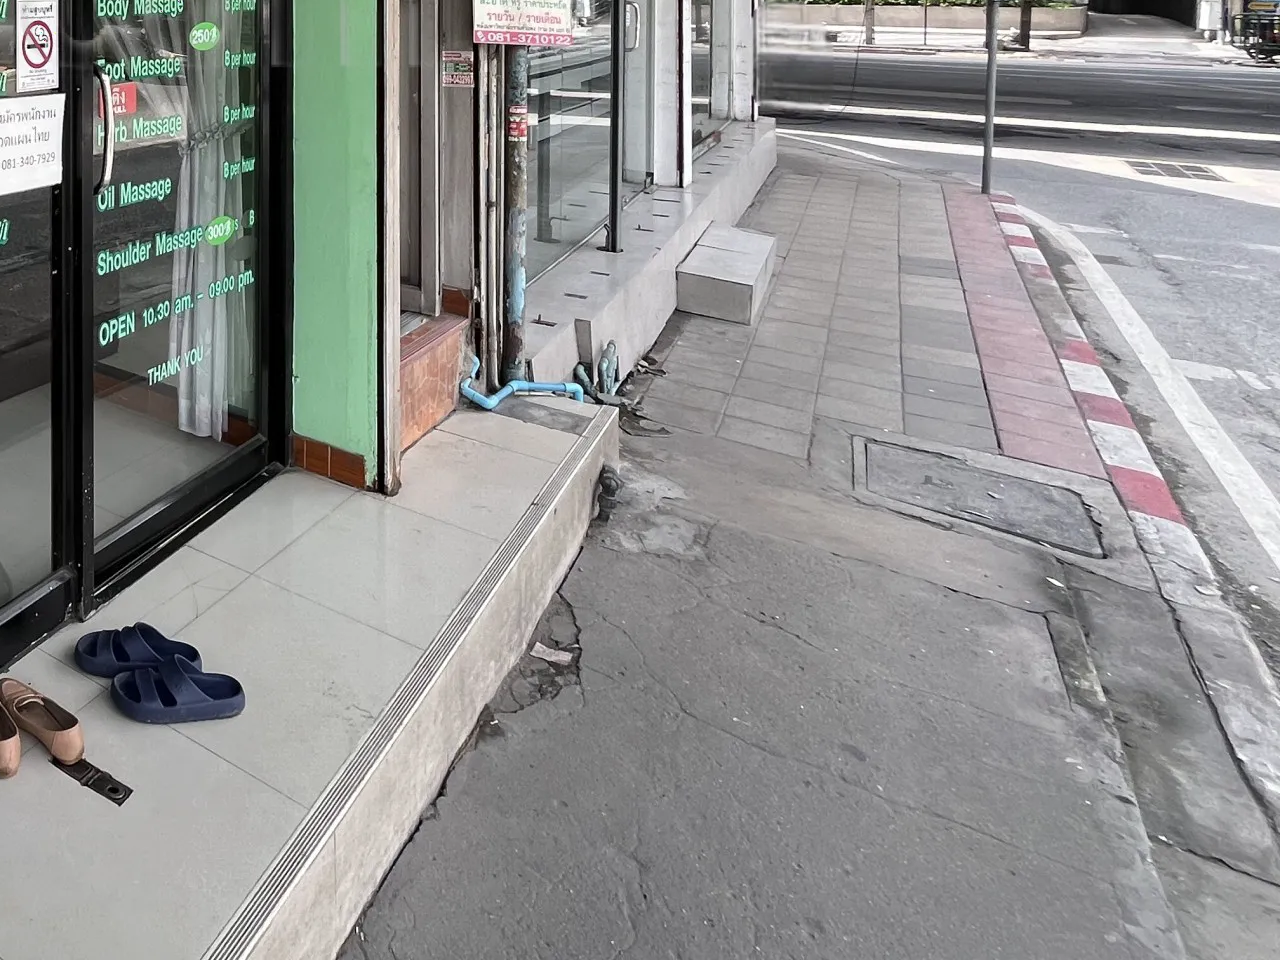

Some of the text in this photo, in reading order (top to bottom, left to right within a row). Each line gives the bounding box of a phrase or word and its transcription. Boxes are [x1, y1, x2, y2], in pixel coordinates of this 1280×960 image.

[231, 0, 241, 15] per
[487, 32, 570, 45] 081-3710122
[131, 56, 180, 78] Massage
[231, 54, 241, 69] per
[242, 50, 256, 66] hour
[230, 108, 241, 121] per
[242, 105, 255, 119] hour
[98, 115, 181, 145] Hrb Massage
[2, 152, 56, 170] 081-340-7929
[230, 163, 240, 177] per
[242, 158, 255, 173] hour
[97, 178, 171, 210] Oil Massage
[97, 228, 203, 276] Shoulder Massage
[99, 311, 135, 346] OPEN
[142, 302, 170, 328] 10.30
[174, 298, 194, 315] am.
[209, 277, 235, 298] 09.00
[238, 271, 255, 292] pm.
[148, 346, 204, 386] THANK YOU
